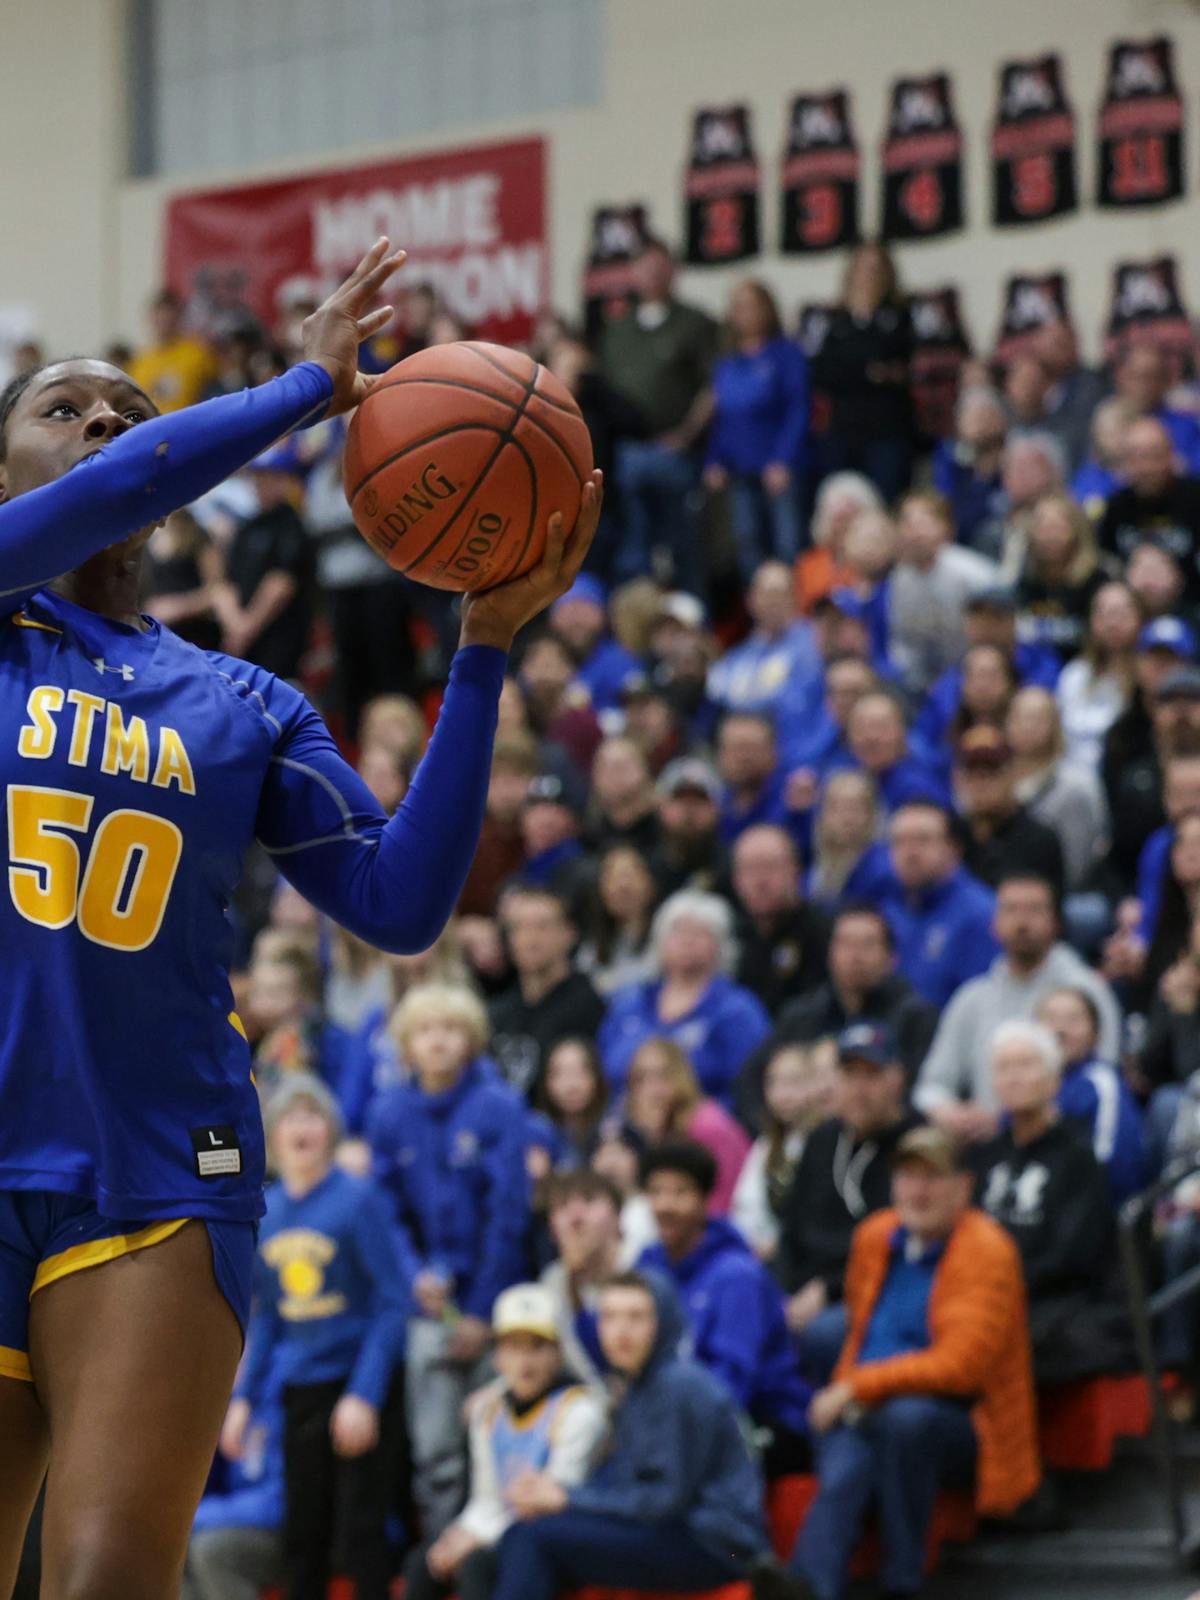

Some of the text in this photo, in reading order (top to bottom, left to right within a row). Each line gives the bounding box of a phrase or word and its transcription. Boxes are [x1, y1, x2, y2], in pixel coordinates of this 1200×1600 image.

[312, 172, 501, 267] HOME
[17, 685, 196, 796] STMA
[6, 784, 183, 951] 50
[208, 1130, 224, 1146] L
